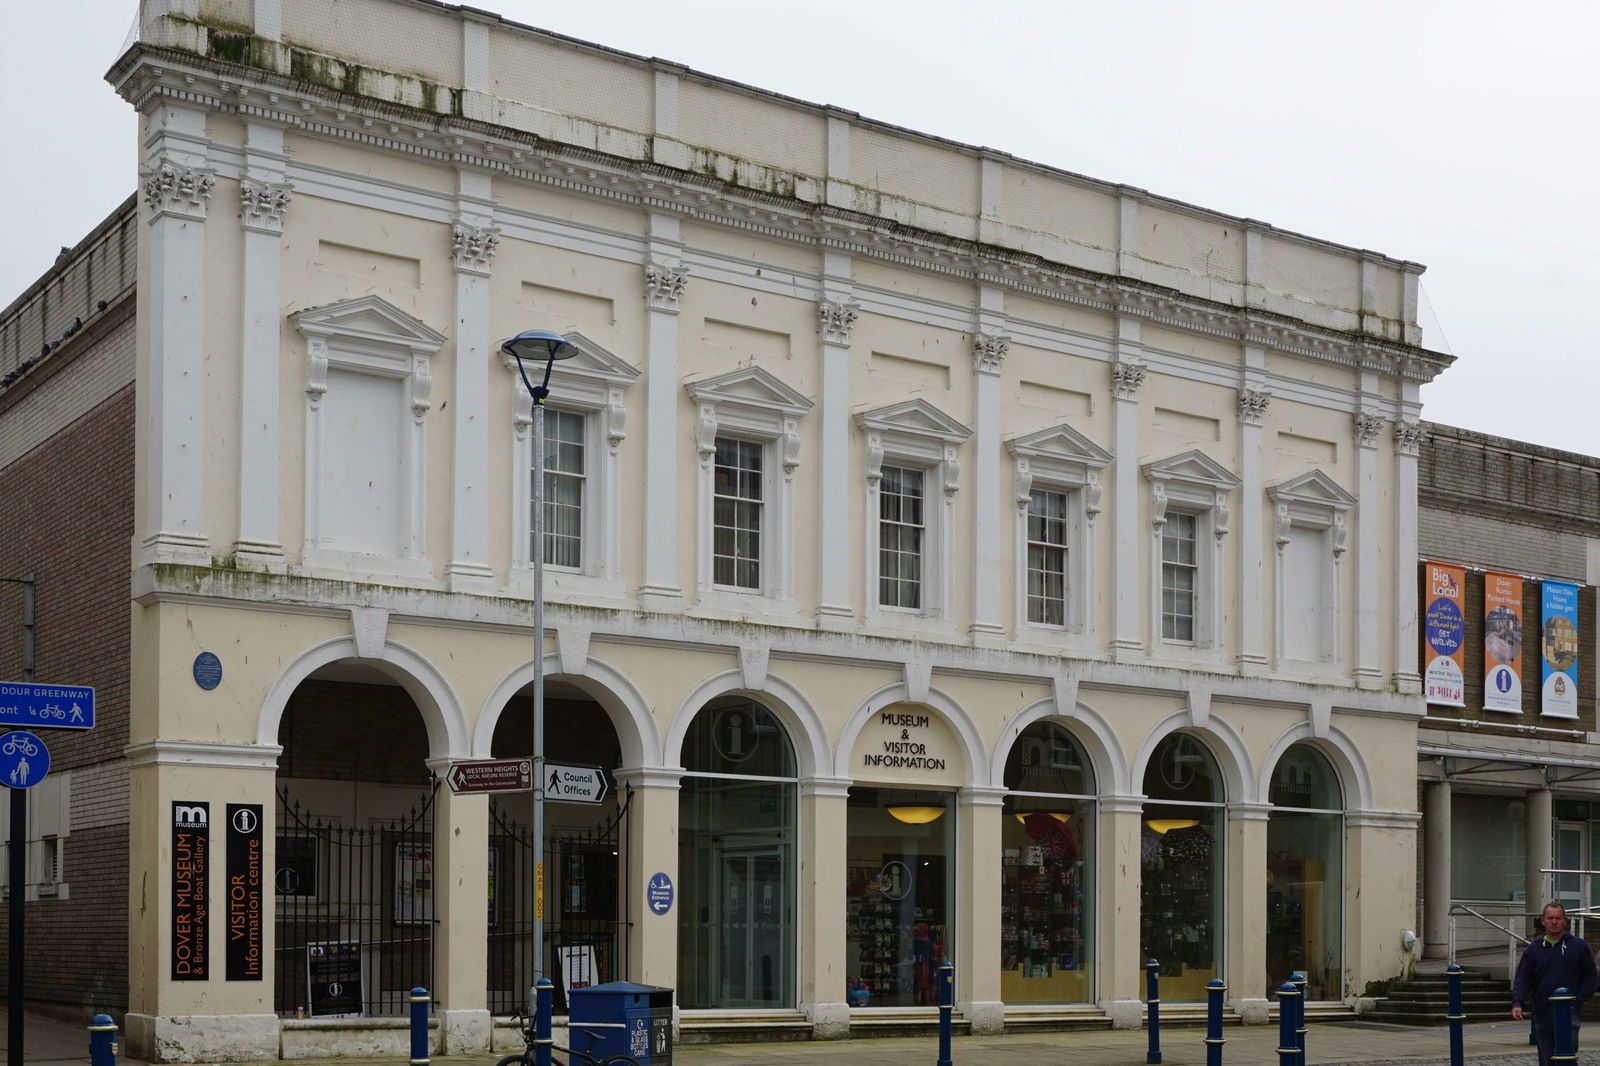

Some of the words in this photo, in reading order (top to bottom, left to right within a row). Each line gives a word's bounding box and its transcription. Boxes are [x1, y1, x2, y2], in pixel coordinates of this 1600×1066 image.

[1433, 568, 1448, 586] Big
[1433, 582, 1458, 598] Local
[1431, 637, 1458, 648] INVOLVED
[2, 686, 30, 696] DOUR
[34, 689, 90, 699] GREENWAY
[882, 713, 928, 727] MUSEUM
[901, 729, 909, 739] &
[884, 741, 926, 754] VISITOR
[864, 754, 945, 770] INFORMATION
[564, 772, 592, 783] Council
[564, 784, 591, 796] Offices
[194, 836, 206, 874] Gallery
[250, 839, 258, 886] centre
[177, 833, 191, 907] MUSEUM
[194, 877, 204, 900] Boat
[194, 904, 206, 925] Age
[232, 874, 245, 940] VISITOR
[246, 891, 258, 975] Information
[177, 913, 191, 974] DOVER
[194, 927, 203, 963] Bronze
[194, 966, 203, 974] &
[654, 1018, 668, 1026] LITTER
[630, 1042, 648, 1050] BOTTLES
